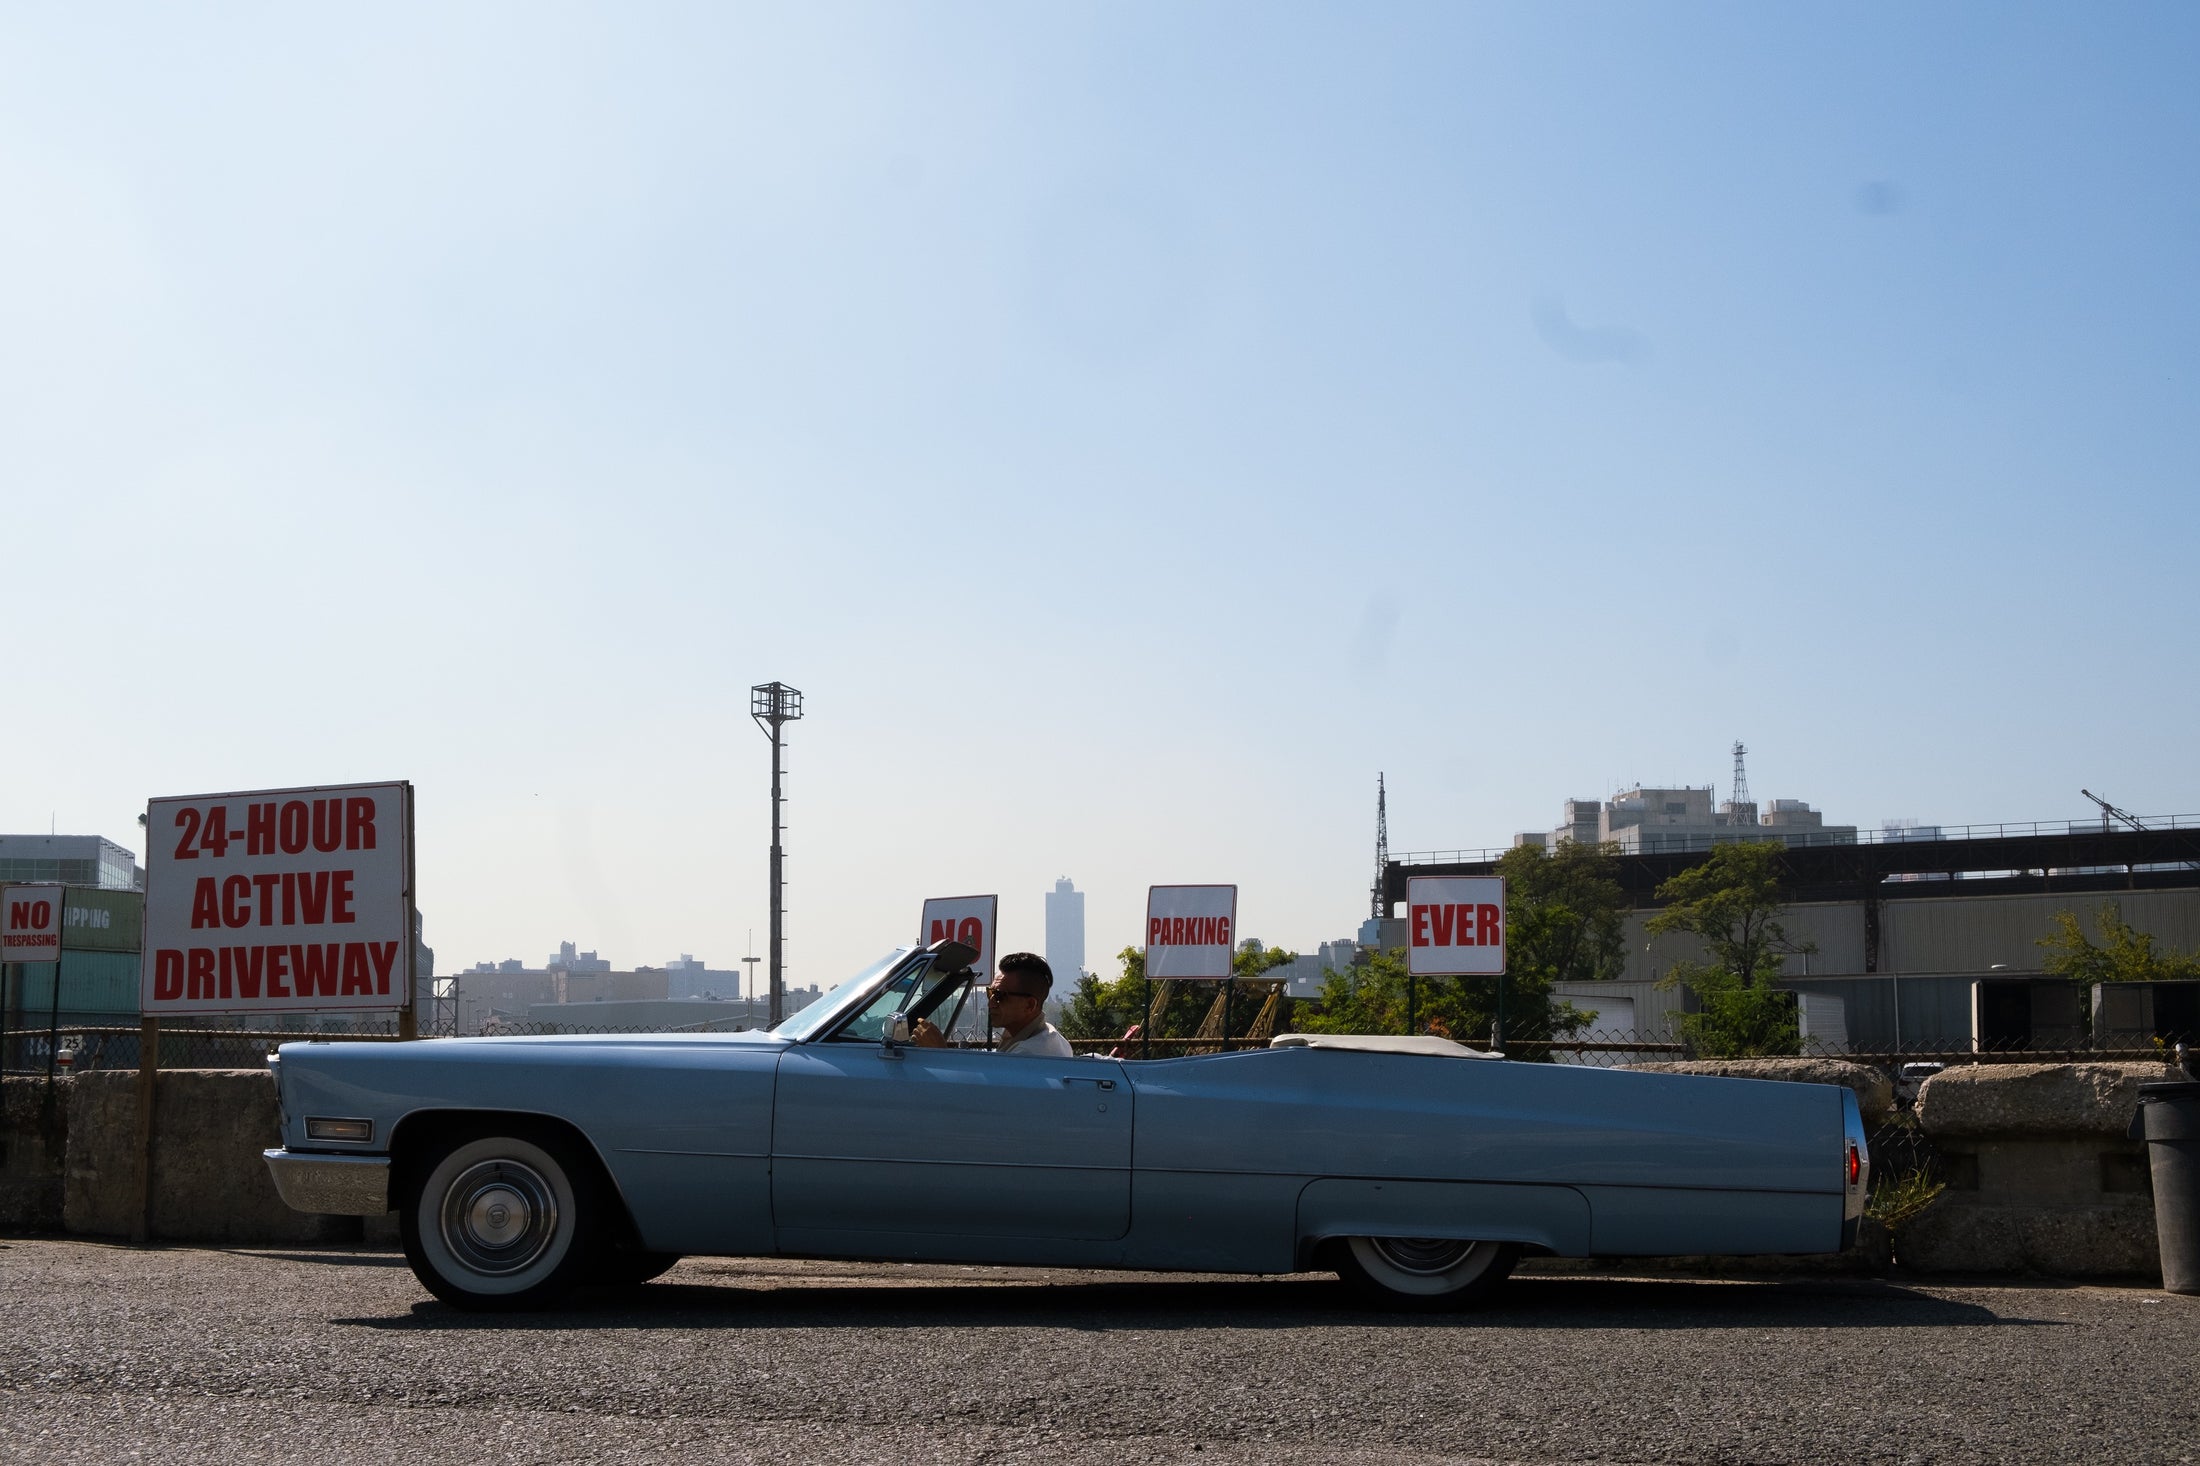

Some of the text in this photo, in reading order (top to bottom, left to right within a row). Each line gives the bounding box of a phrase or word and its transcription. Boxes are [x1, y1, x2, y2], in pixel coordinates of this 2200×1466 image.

[174, 797, 377, 860] 24-HOUR
[10, 900, 51, 930] NO
[191, 870, 356, 929] ACTIVE
[3, 934, 57, 948] TRESPASSING
[1149, 916, 1230, 946] PARKING
[1411, 903, 1501, 947] EVER
[154, 941, 399, 1001] DRIVEWAY
[64, 1038, 80, 1050] 25
